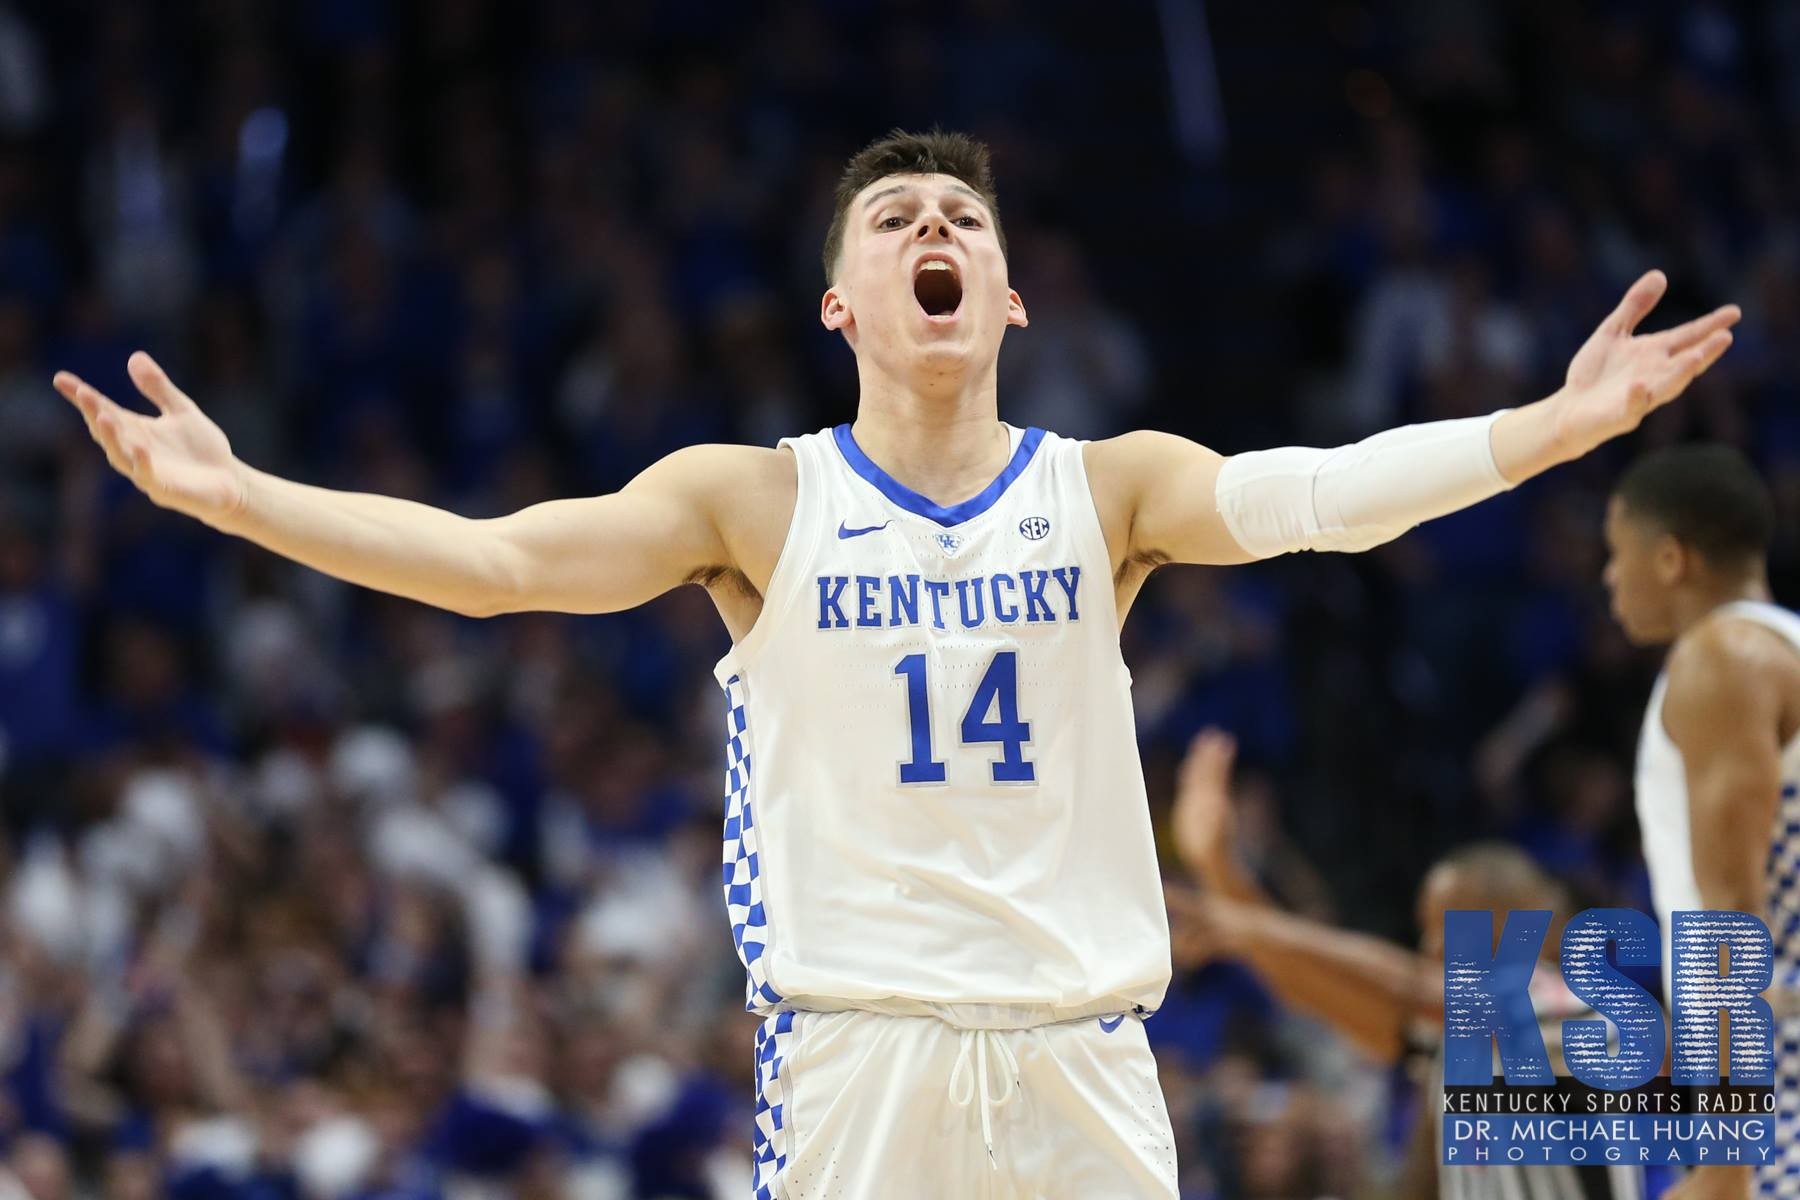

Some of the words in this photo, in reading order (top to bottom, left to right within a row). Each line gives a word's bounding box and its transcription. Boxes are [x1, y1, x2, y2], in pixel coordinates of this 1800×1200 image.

[1021, 517, 1049, 540] SEC
[817, 566, 1081, 630] KENTUCKY
[893, 650, 1036, 785] 14
